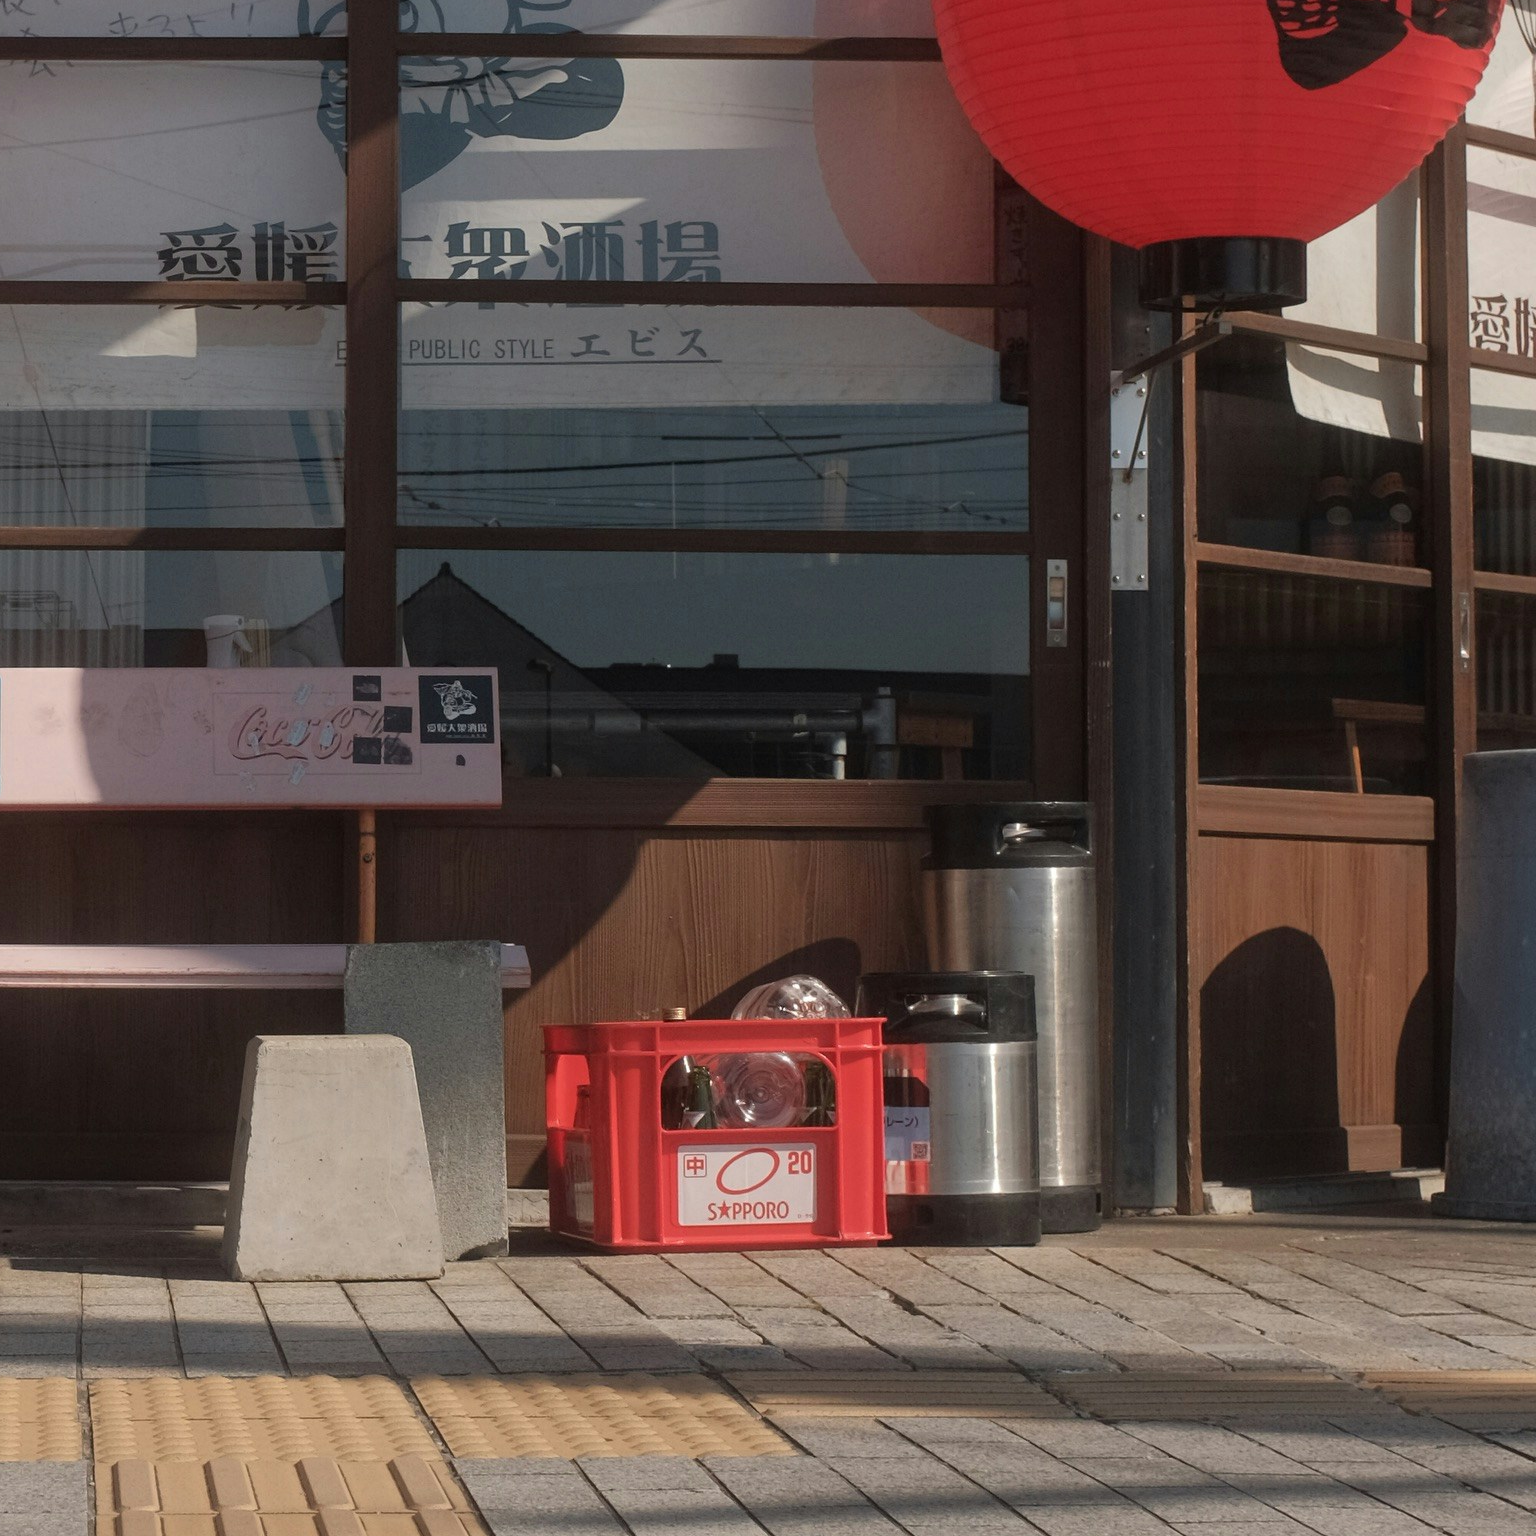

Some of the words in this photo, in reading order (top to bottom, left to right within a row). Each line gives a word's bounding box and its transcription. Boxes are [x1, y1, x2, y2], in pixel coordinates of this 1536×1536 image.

[409, 339, 481, 360] PUBLIC
[494, 338, 555, 359] STYLE
[570, 326, 708, 358] エビス
[686, 1156, 704, 1175] 中
[787, 1150, 812, 1175] 20
